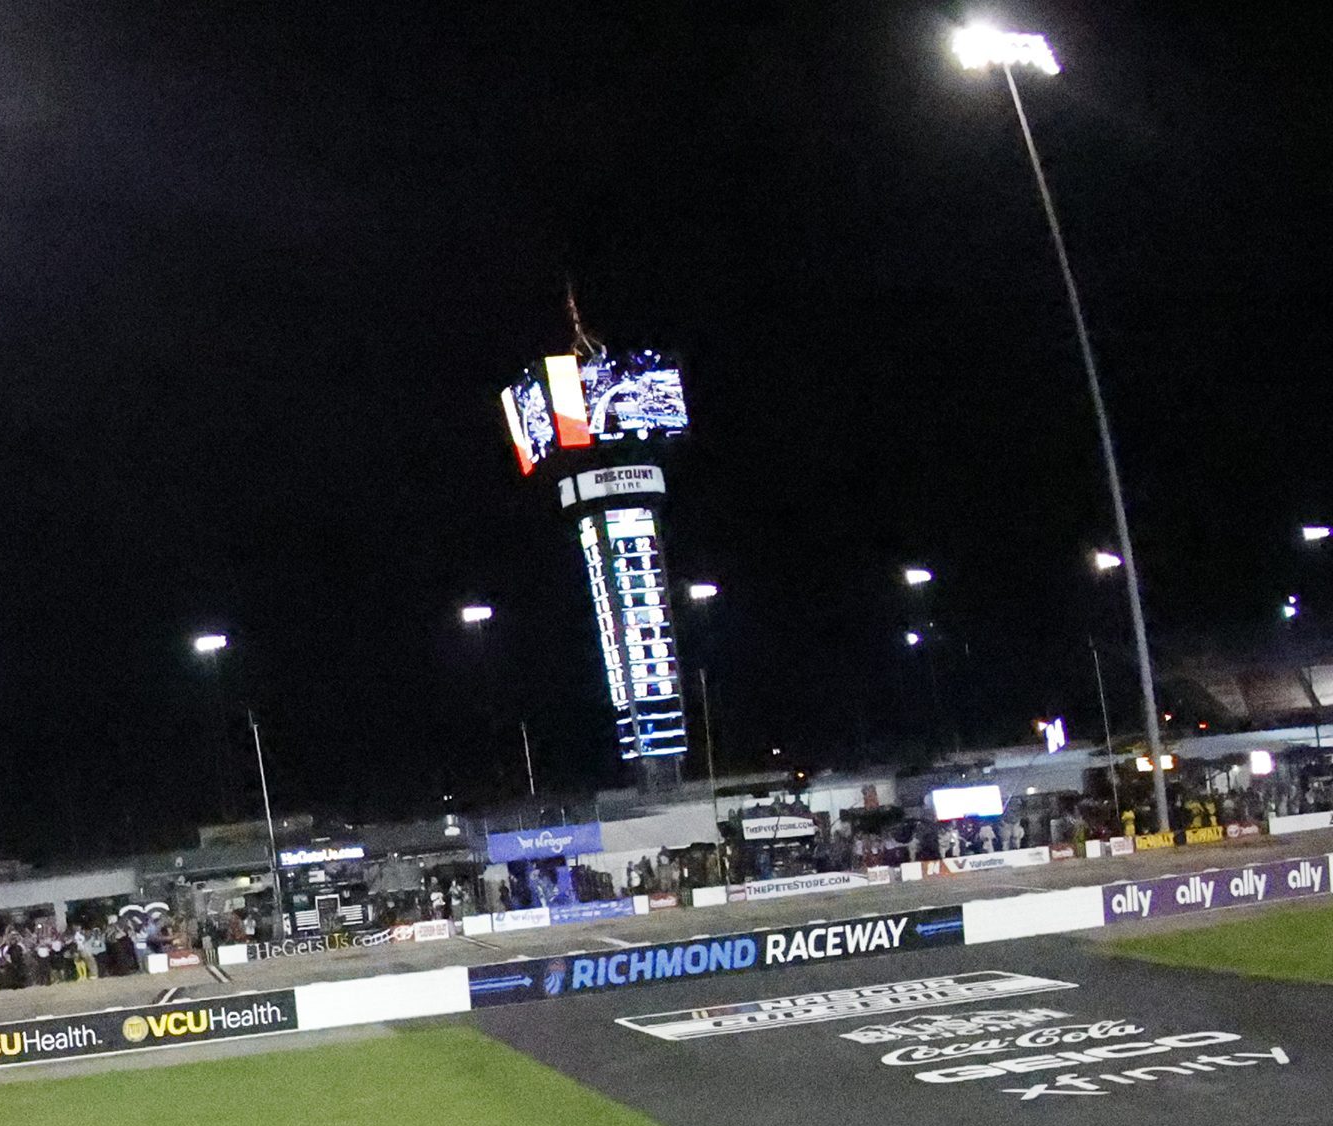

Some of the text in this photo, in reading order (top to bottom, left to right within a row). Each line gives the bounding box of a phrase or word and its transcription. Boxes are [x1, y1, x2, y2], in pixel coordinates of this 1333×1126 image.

[594, 467, 654, 486] DISCOUNT
[1175, 877, 1214, 908] ally
[1229, 870, 1267, 900] ally
[1287, 862, 1323, 894] ally
[1111, 885, 1152, 917] ally
[765, 917, 908, 965] RACEWAY
[572, 937, 757, 990] RICHMOND
[880, 1019, 1144, 1066] Coca-Cola
[914, 1031, 1242, 1083] GEICO
